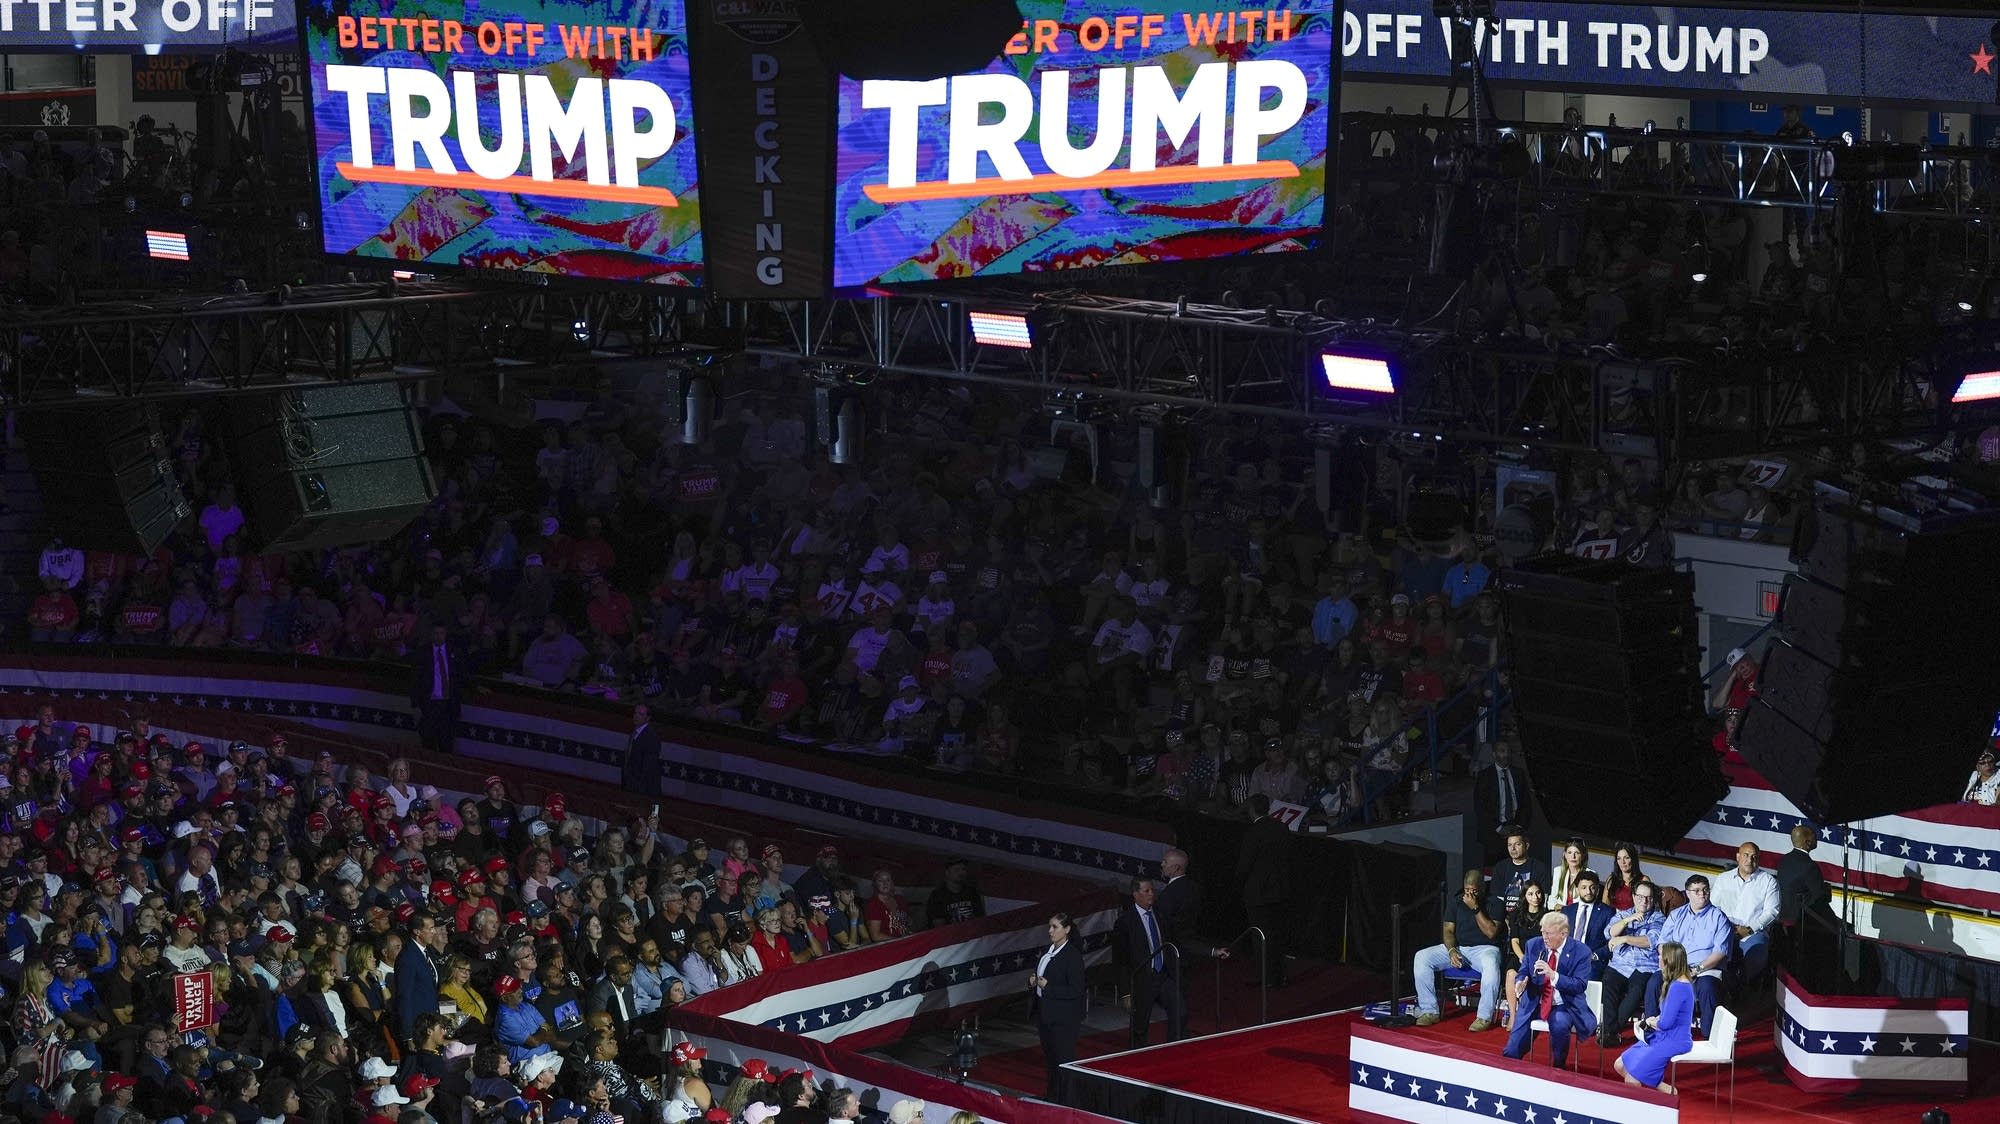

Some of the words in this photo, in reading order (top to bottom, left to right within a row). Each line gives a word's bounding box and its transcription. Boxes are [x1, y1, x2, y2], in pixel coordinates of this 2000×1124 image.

[161, 0, 274, 32] OFF
[337, 15, 464, 54] BETTER
[477, 20, 545, 57] OFF
[557, 24, 654, 62] WITH
[1078, 13, 1166, 53] OFF
[1185, 9, 1293, 47] WITH
[1588, 21, 1770, 74] TRUMP
[136, 71, 185, 92] SERVI
[326, 64, 677, 188] TRUMP
[862, 58, 1309, 189] TRUMP
[752, 53, 783, 286] DECKING
[51, 554, 73, 565] USA
[1270, 806, 1301, 826] 47
[185, 977, 195, 1028] TRUMP
[194, 980, 203, 1021] VANCE
